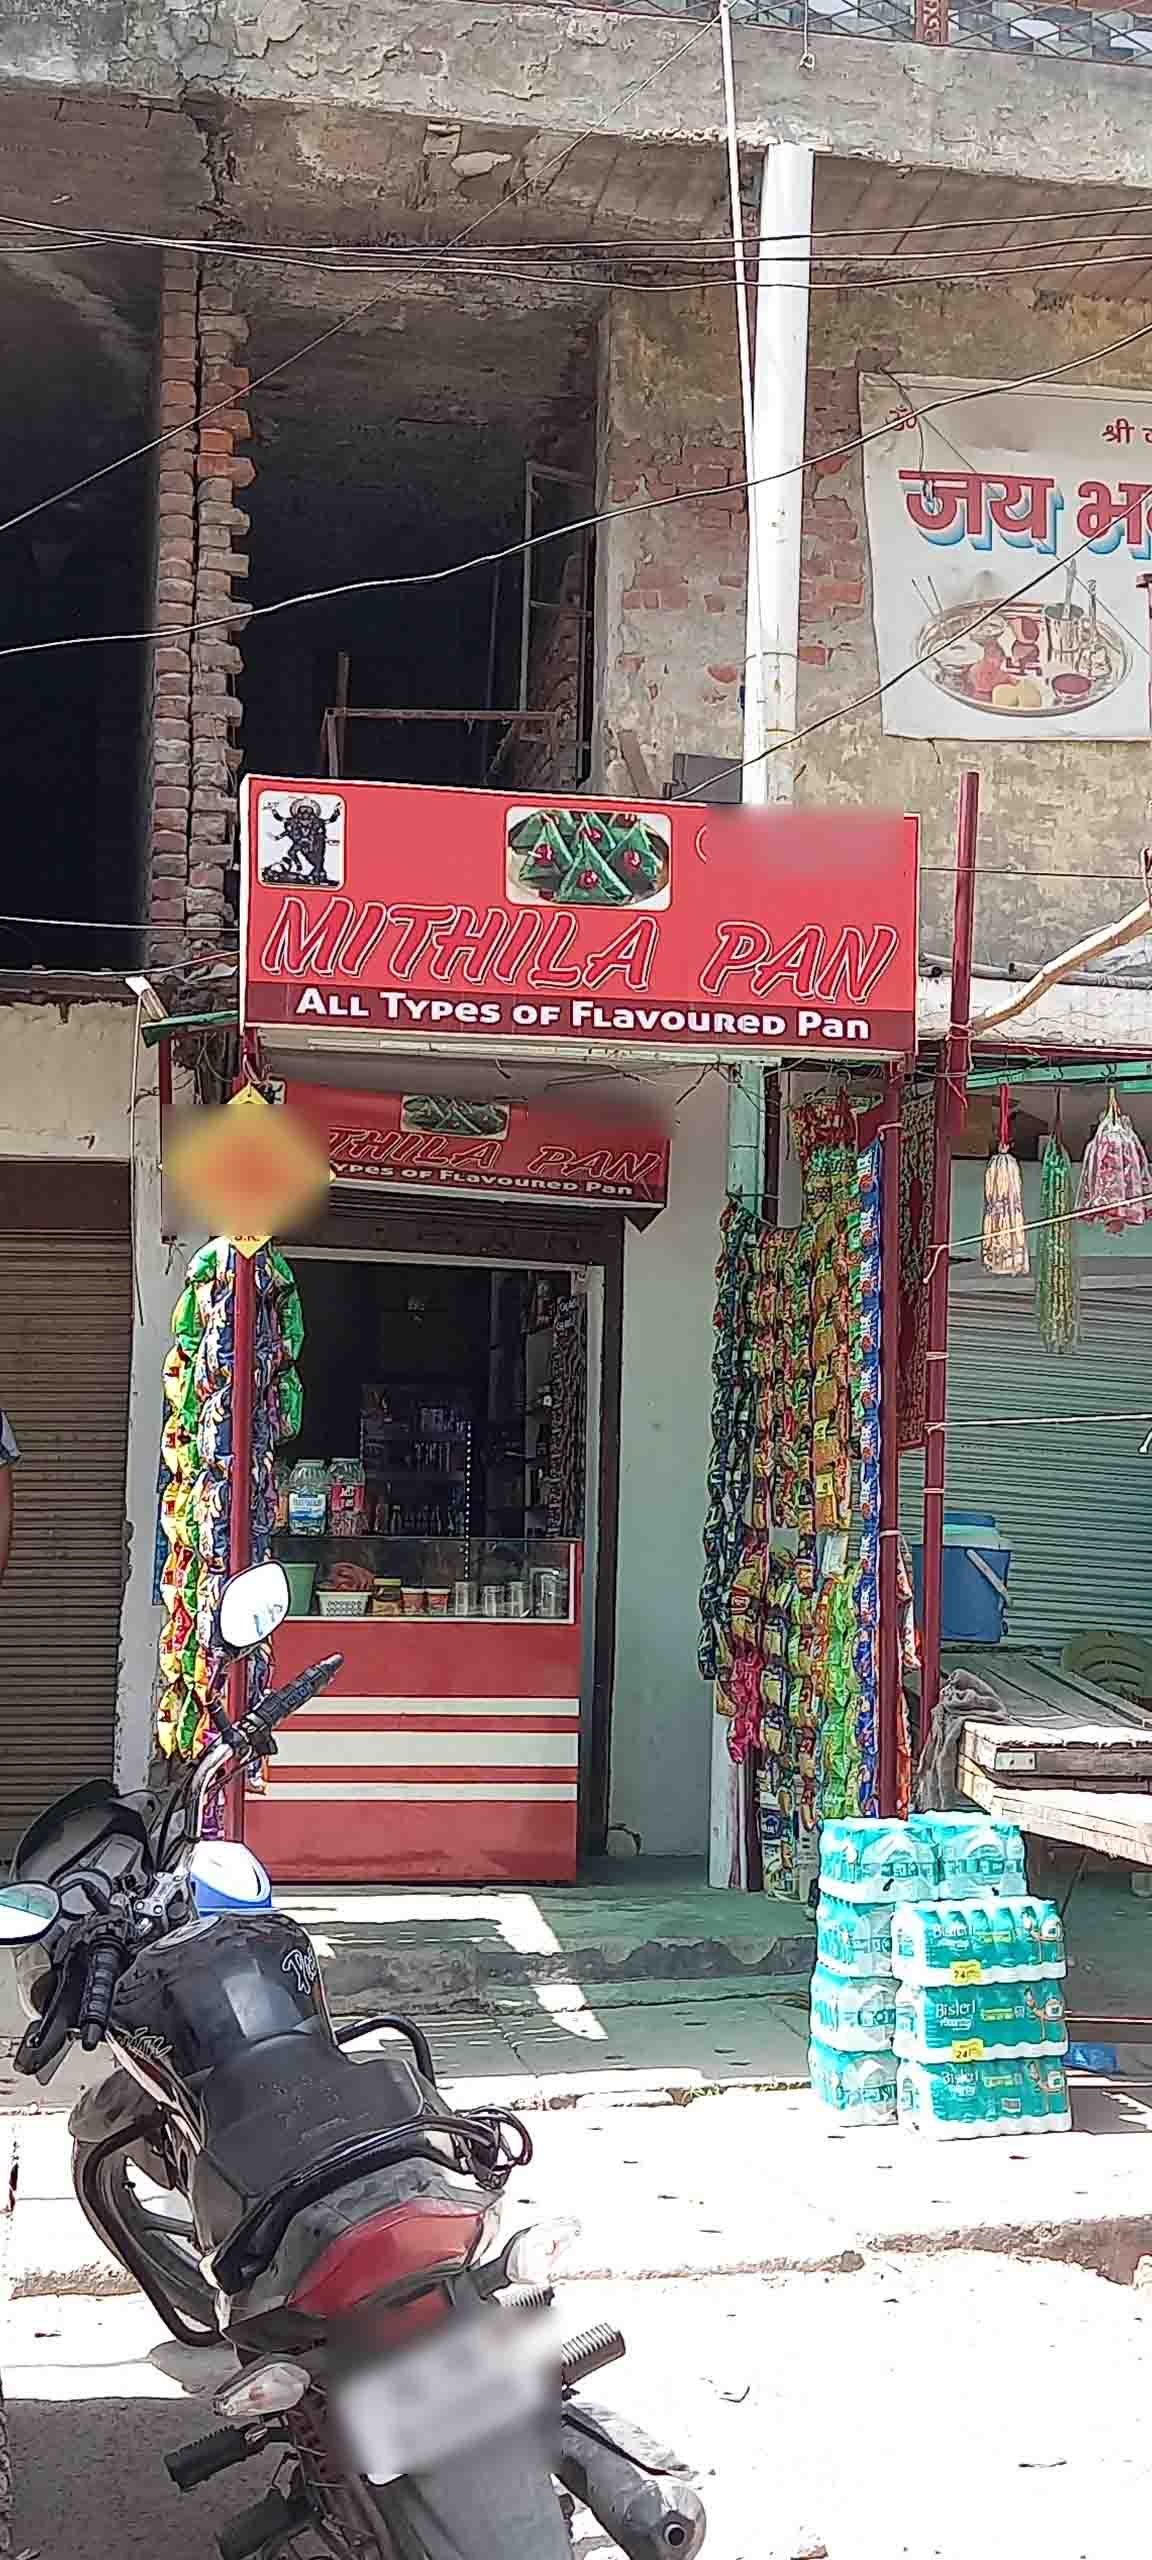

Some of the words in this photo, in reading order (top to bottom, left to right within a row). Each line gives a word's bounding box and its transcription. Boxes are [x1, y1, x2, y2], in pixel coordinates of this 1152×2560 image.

[1102, 418, 1135, 444] श्री
[898, 469, 1060, 550] जय
[1076, 480, 1152, 552] भ
[261, 896, 659, 991] MITHILA
[699, 920, 899, 1005] PAN
[798, 1011, 869, 1040] Pan
[329, 1127, 501, 1168] THILA
[528, 1145, 663, 1182] PAN
